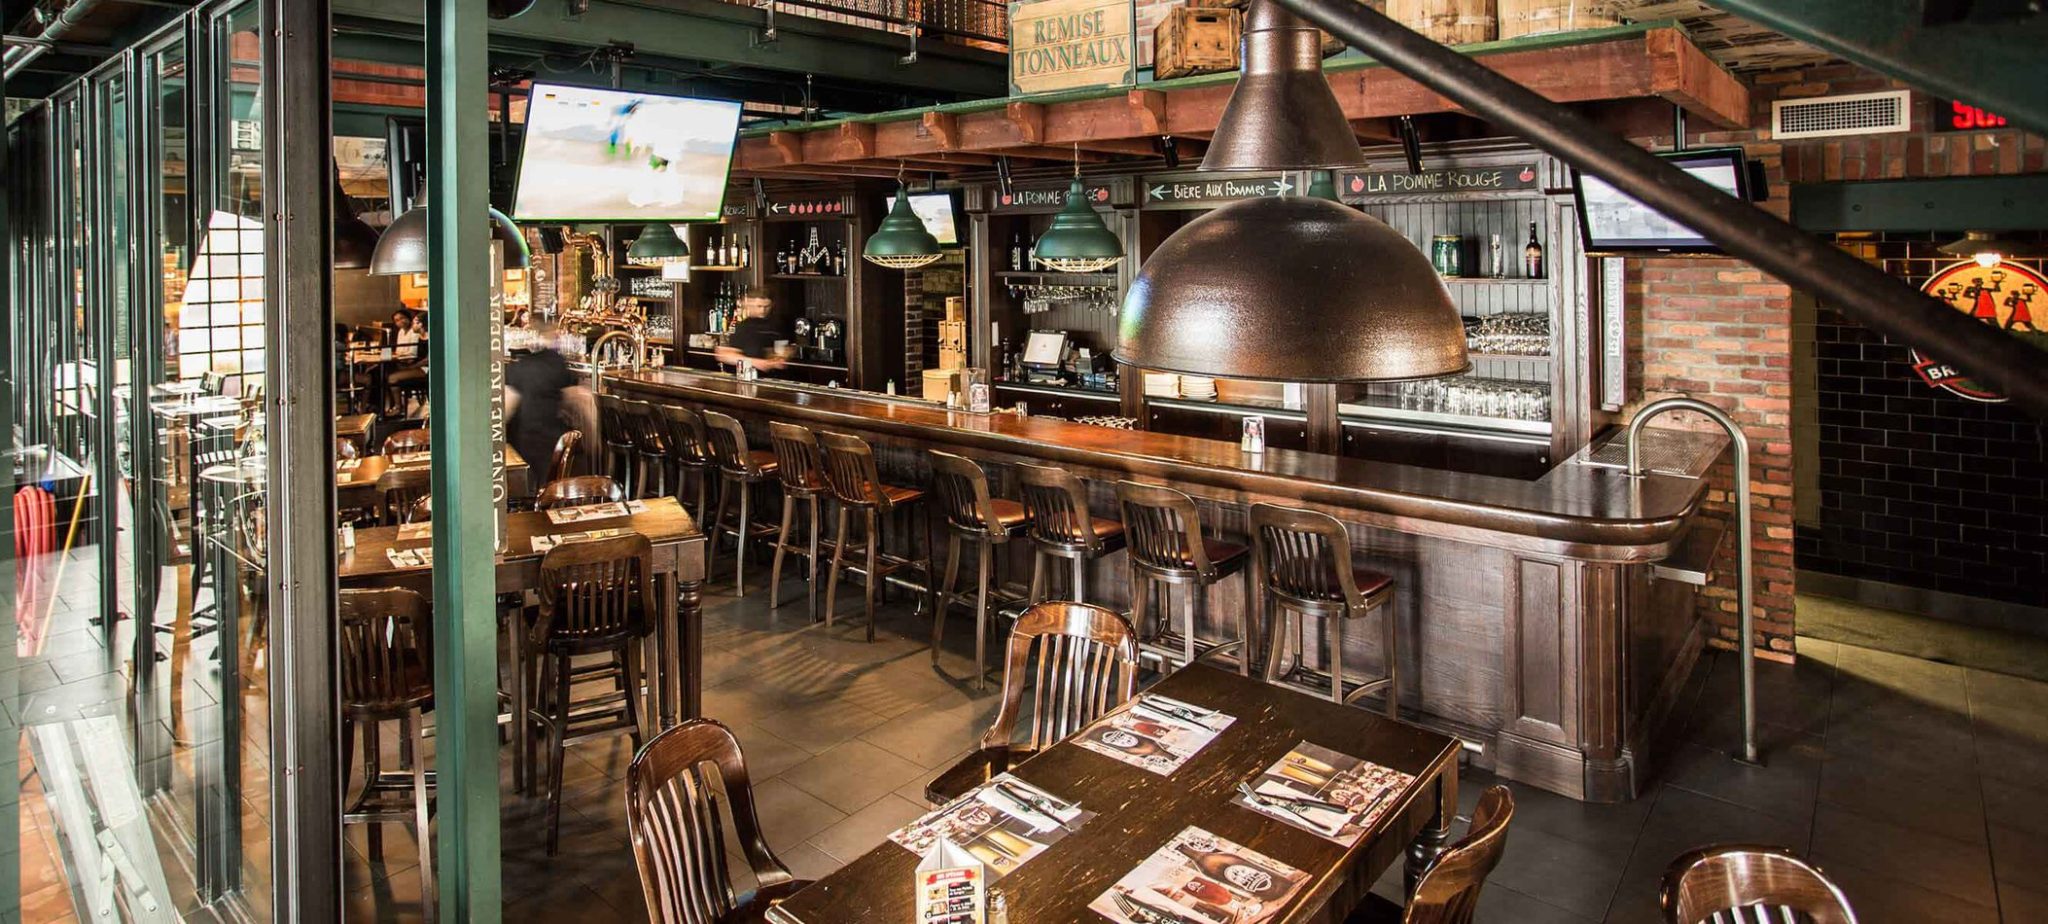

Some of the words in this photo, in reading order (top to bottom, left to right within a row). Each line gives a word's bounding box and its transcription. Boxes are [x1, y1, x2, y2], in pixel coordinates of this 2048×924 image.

[1034, 10, 1105, 45] REMISE
[1016, 37, 1127, 76] TONNEAUX
[1205, 183, 1223, 197] AUX
[1367, 175, 1387, 192] LA
[1393, 173, 1443, 190] POMME
[1448, 171, 1503, 187] ROUGE
[1012, 192, 1023, 205] LA
[1025, 190, 1061, 205] POMME
[492, 449, 505, 503] ONE
